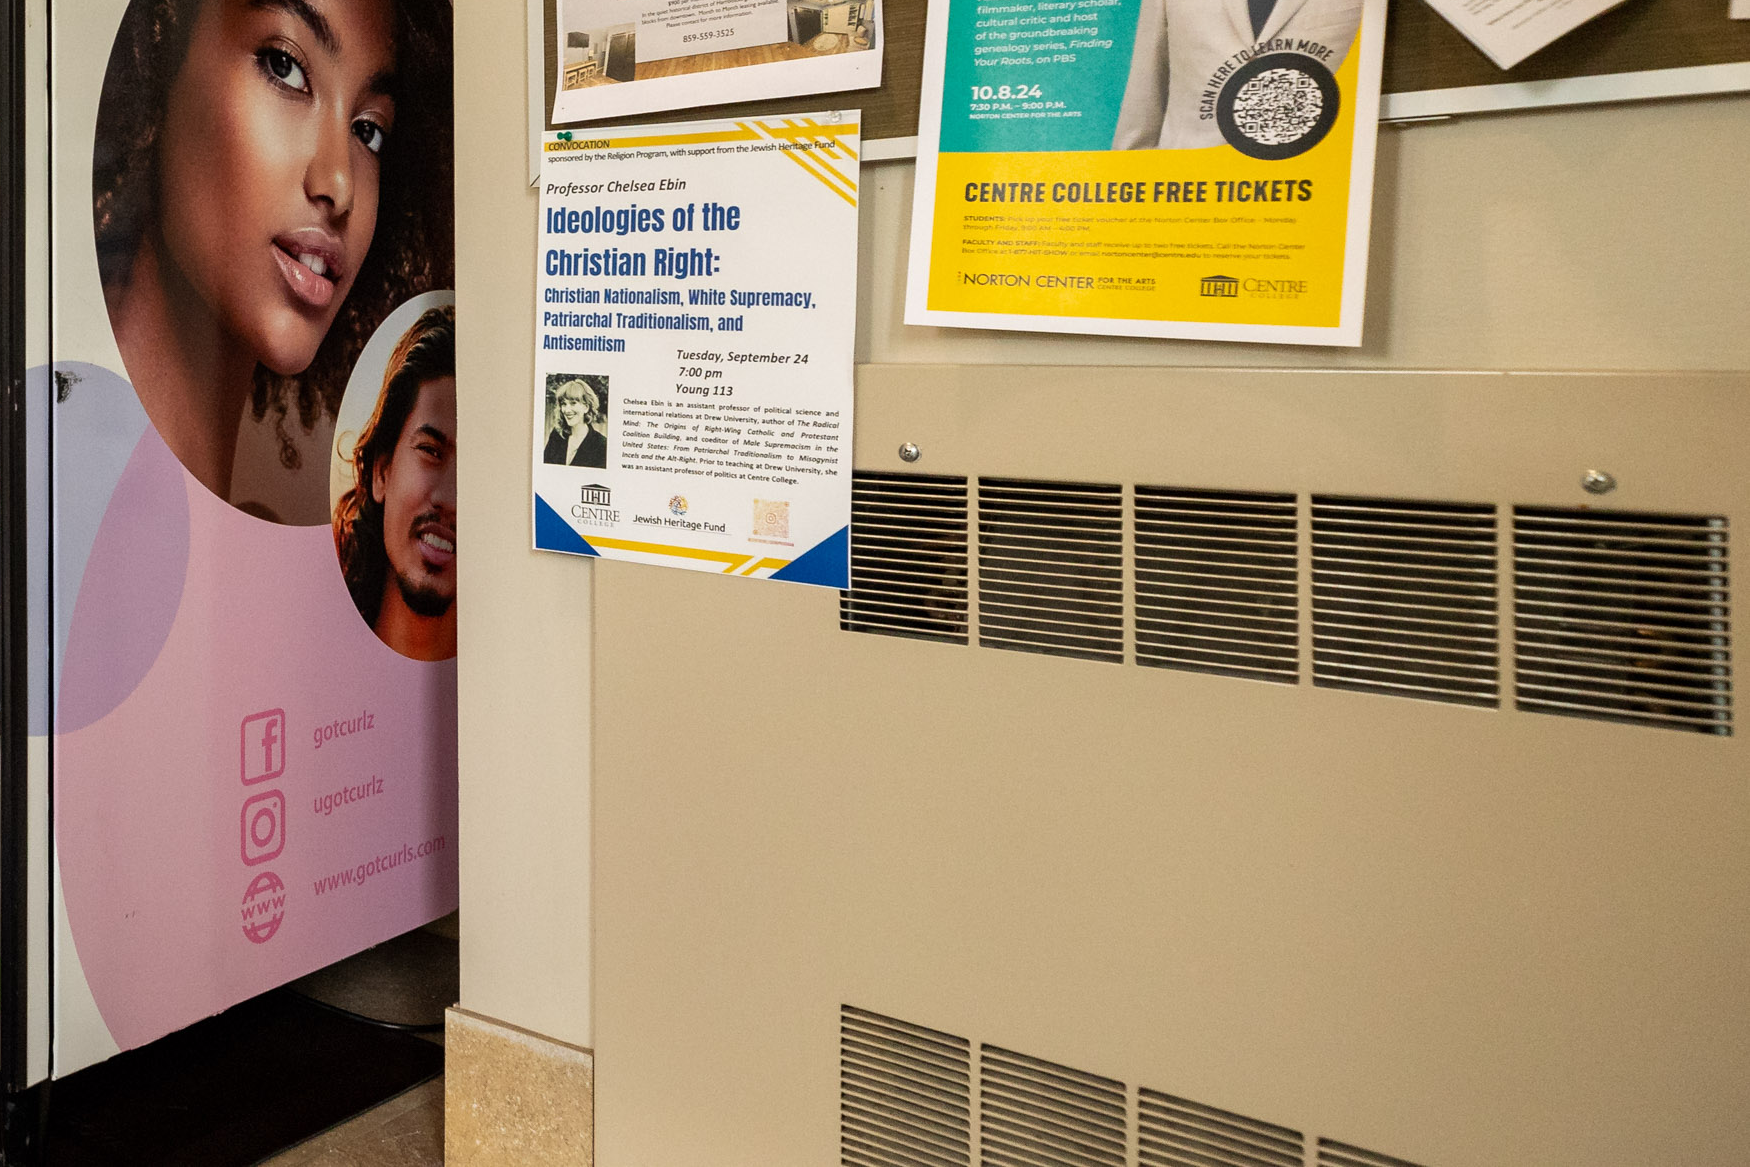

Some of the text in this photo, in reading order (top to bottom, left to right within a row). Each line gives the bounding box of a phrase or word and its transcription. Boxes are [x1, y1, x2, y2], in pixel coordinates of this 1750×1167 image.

[683, 28, 735, 43] 859-559-3525
[971, 84, 1042, 100] 10.8.24
[548, 140, 611, 151] CONVOCATION
[546, 178, 687, 196] Professor Chelsea Ebin
[964, 179, 1313, 203] CENTRE COLLEGE FREE TICKETS
[546, 202, 741, 236] Ideologies of the
[545, 247, 721, 279] Christian Right:
[964, 272, 1095, 290] NORTON CENTER
[545, 288, 817, 309] Christian Nationalism, White Supremacy,
[544, 311, 743, 333] Patriarchal Traditionalism, and
[543, 335, 626, 353] Antisemitism
[676, 348, 809, 366] Tuesday, September 24
[679, 366, 723, 382] 7:00 pm
[675, 383, 733, 397] Young 113
[313, 710, 375, 749] gotcurlz
[313, 775, 384, 816] ugotcurlz
[313, 835, 446, 896] www.gotcurls.com
[241, 894, 286, 921] www
